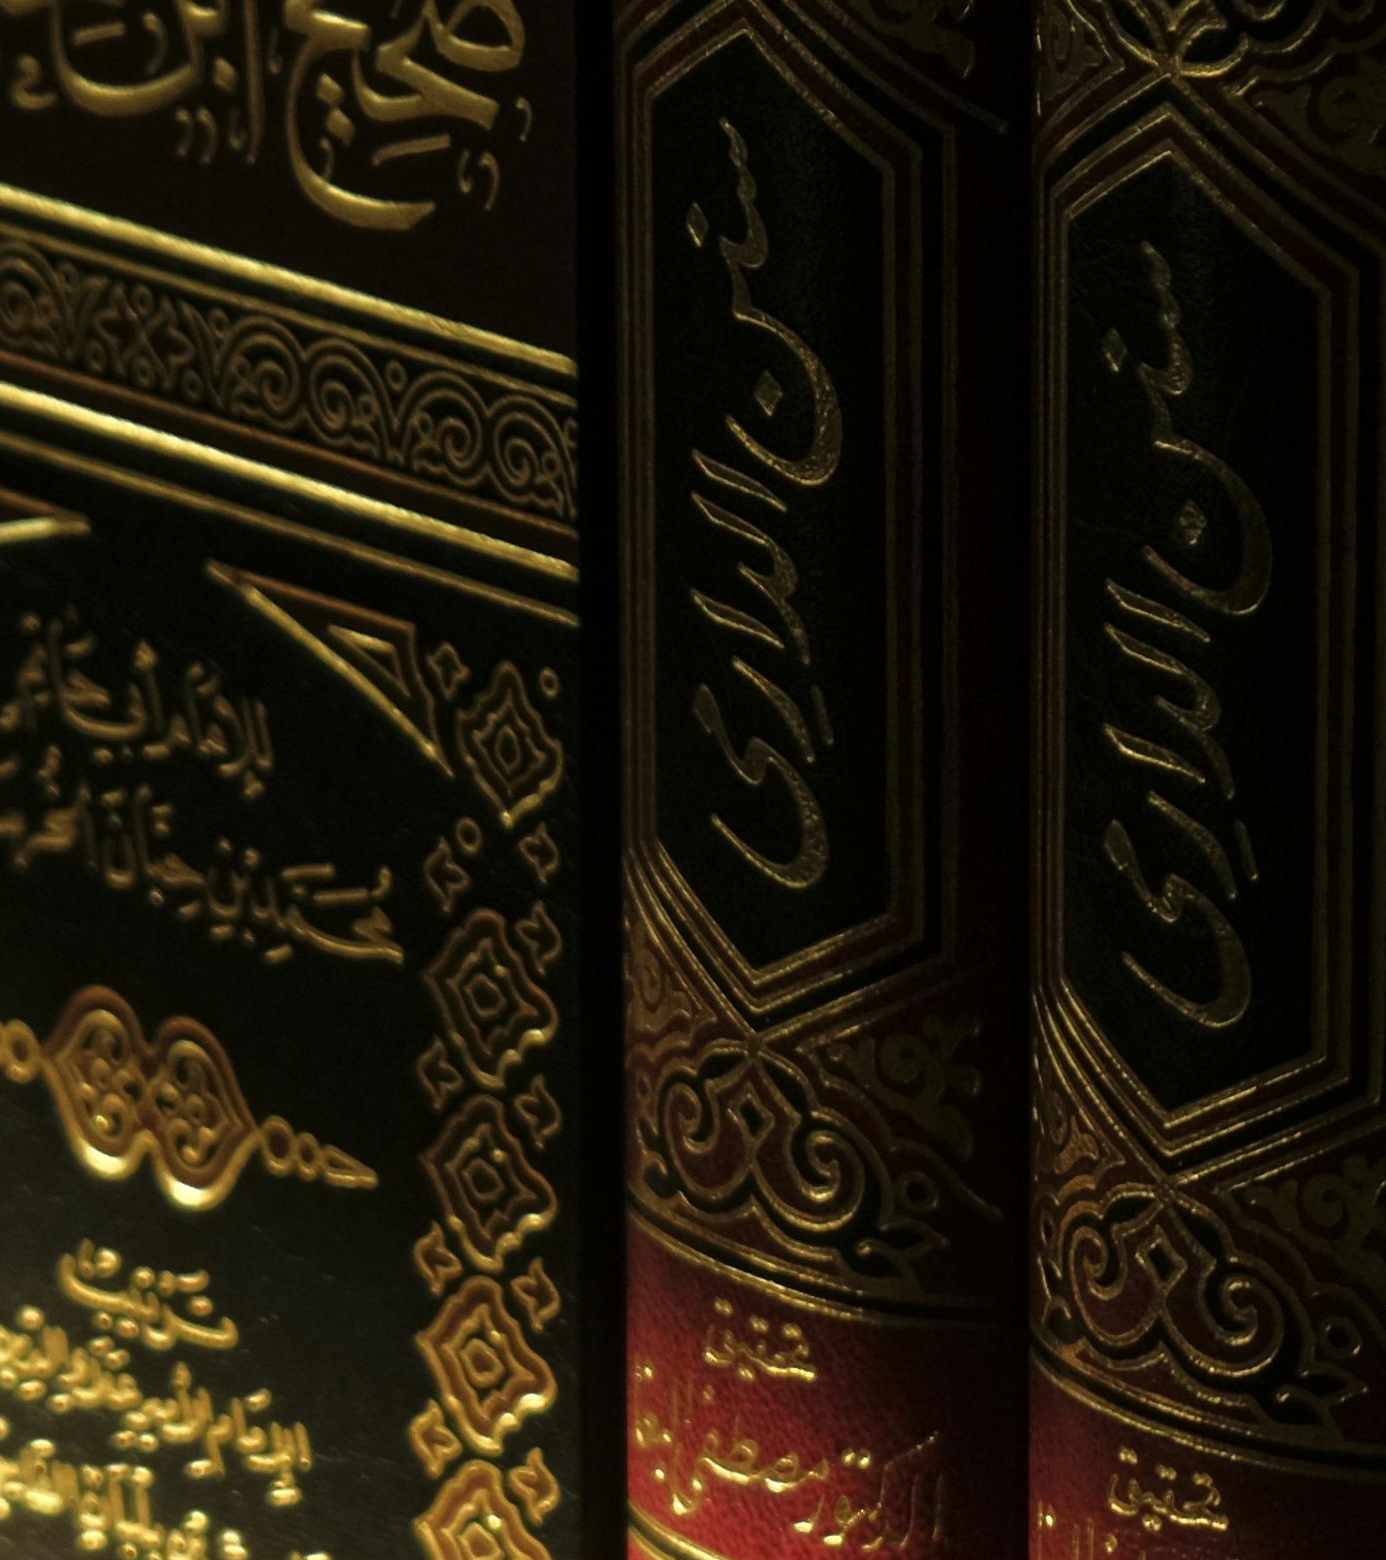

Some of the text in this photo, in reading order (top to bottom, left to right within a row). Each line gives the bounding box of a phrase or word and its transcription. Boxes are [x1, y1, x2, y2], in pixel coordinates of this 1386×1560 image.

[686, 117, 842, 486] سنن
[1101, 240, 1272, 617] سنن
[702, 1298, 819, 1383] تحقيق
[793, 1427, 951, 1552] الدكتور
[1106, 1448, 1230, 1533] تحقيق
